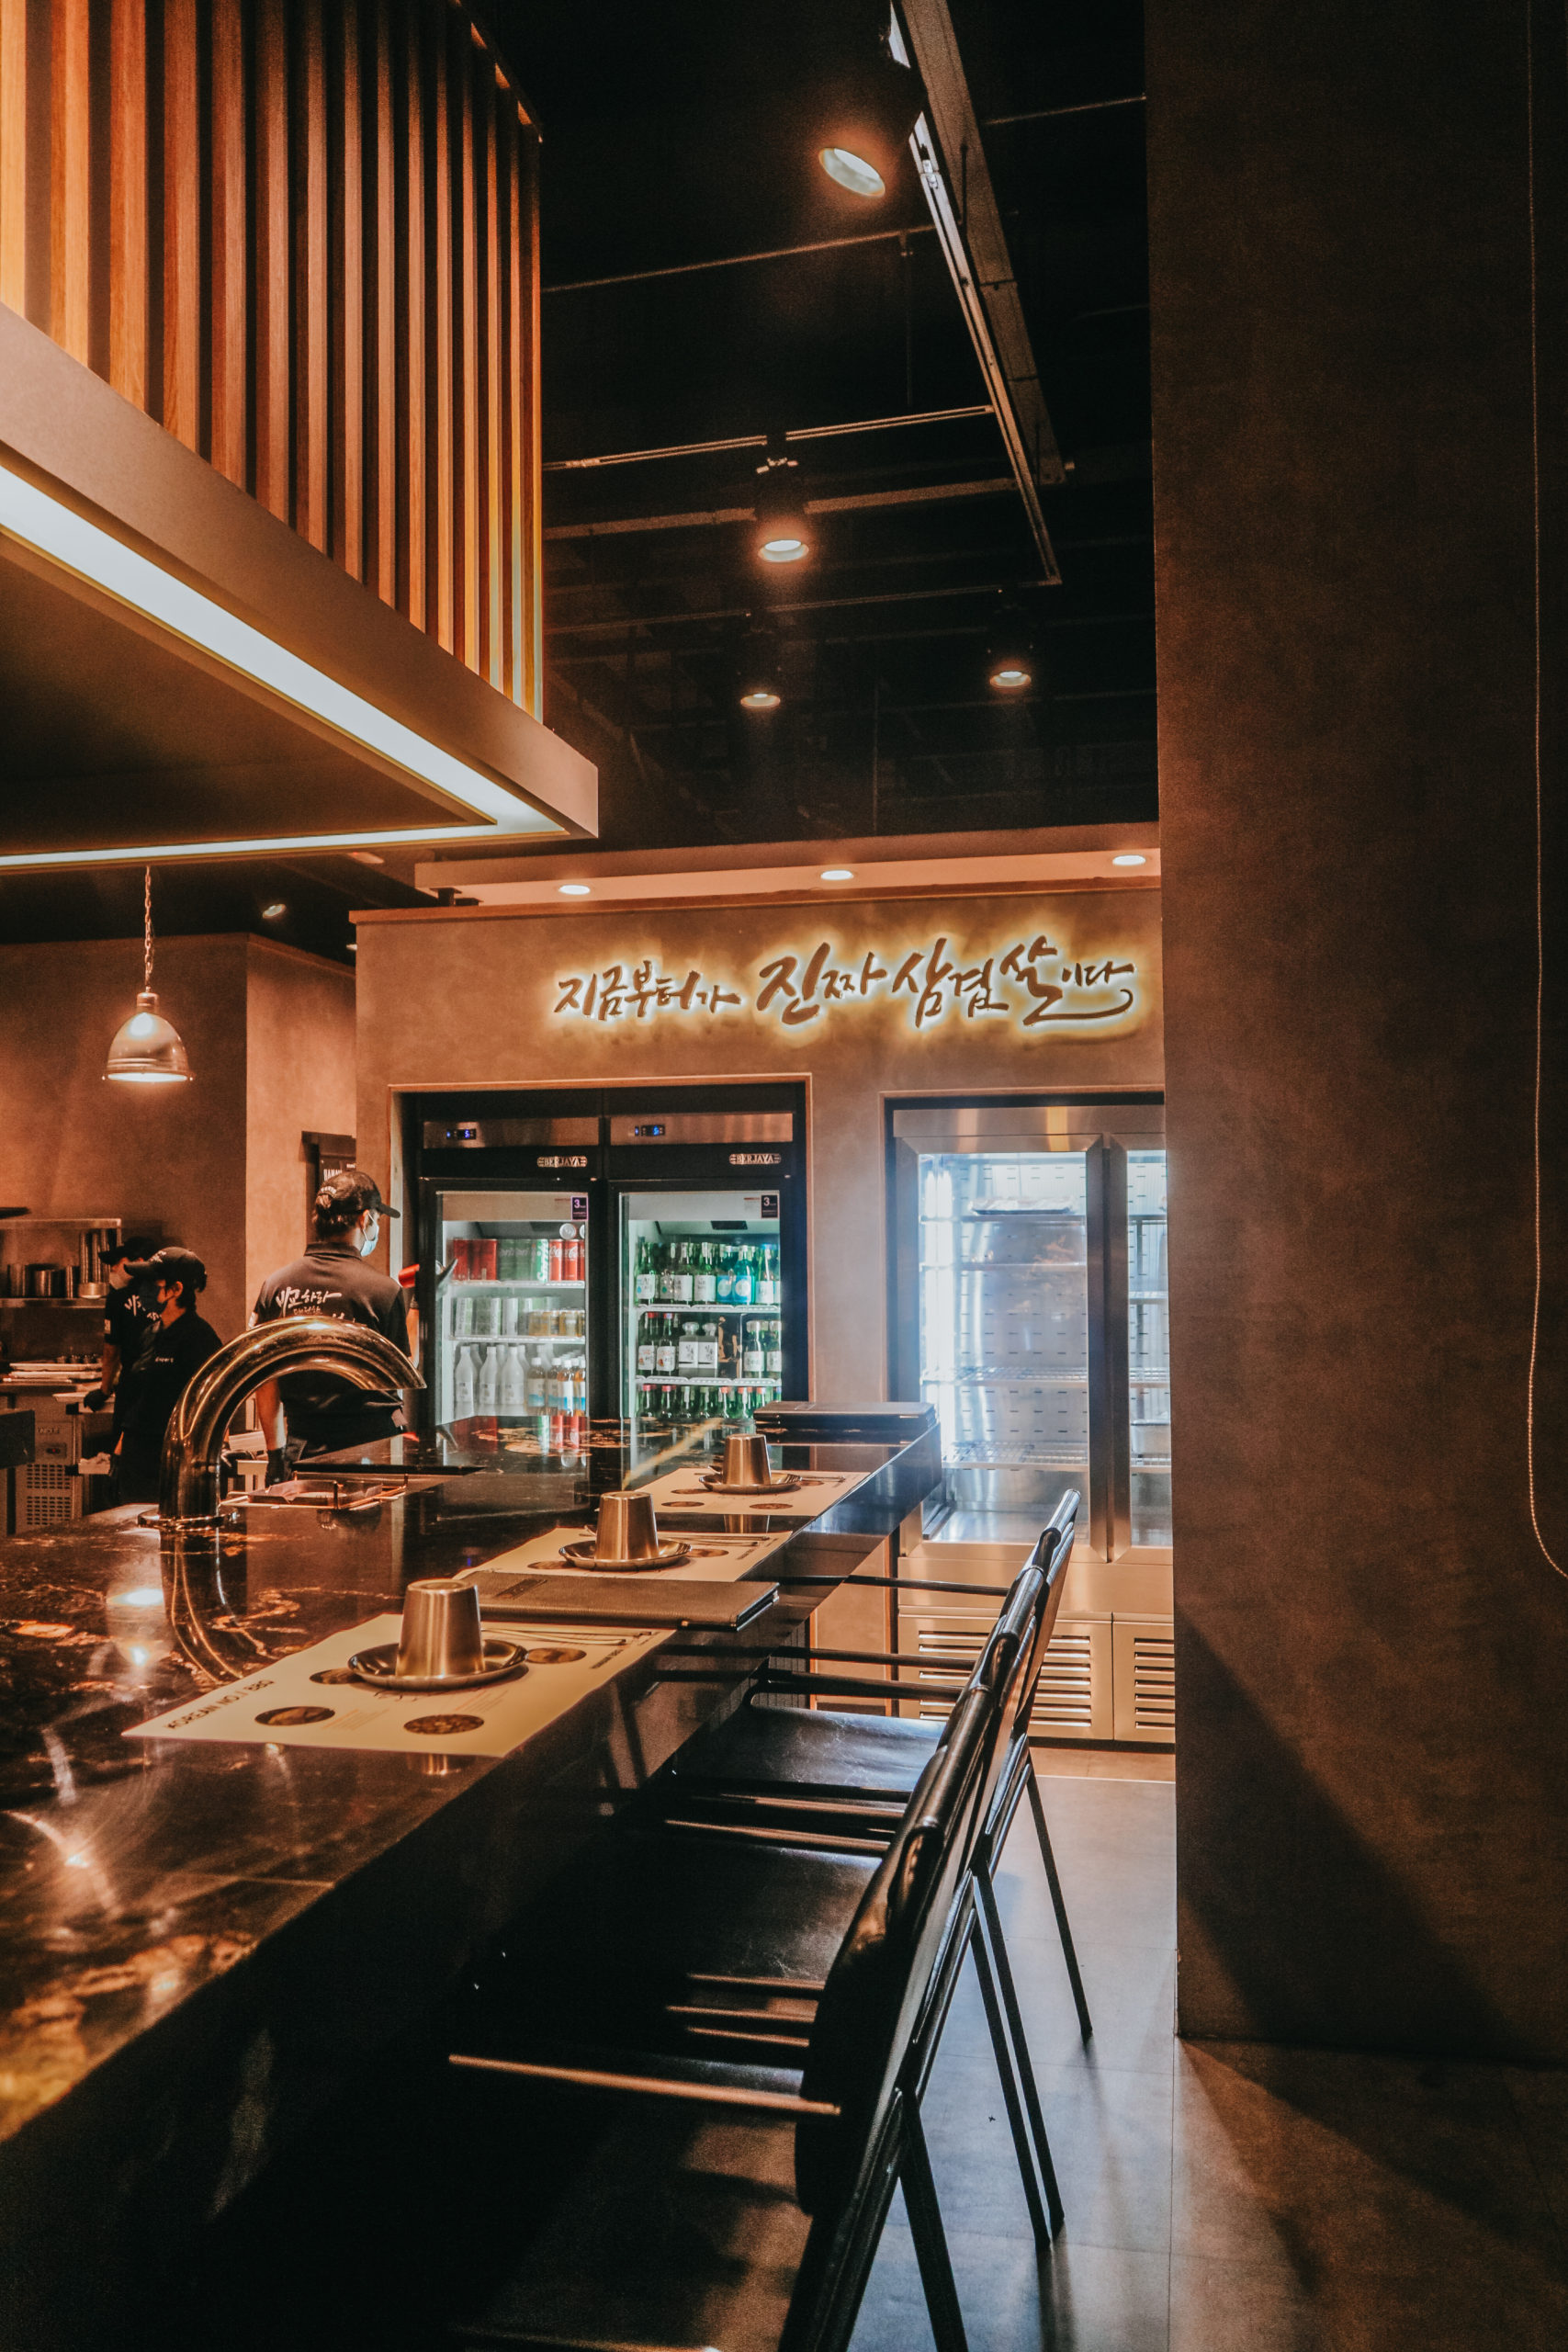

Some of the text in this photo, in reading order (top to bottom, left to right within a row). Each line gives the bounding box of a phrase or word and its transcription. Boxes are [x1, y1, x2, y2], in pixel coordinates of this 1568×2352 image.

[554, 934, 1135, 1029] 지금부터가 진짜 삼겹살이다
[543, 1156, 582, 1168] BERJAYA
[736, 1153, 774, 1164] BERJAYA
